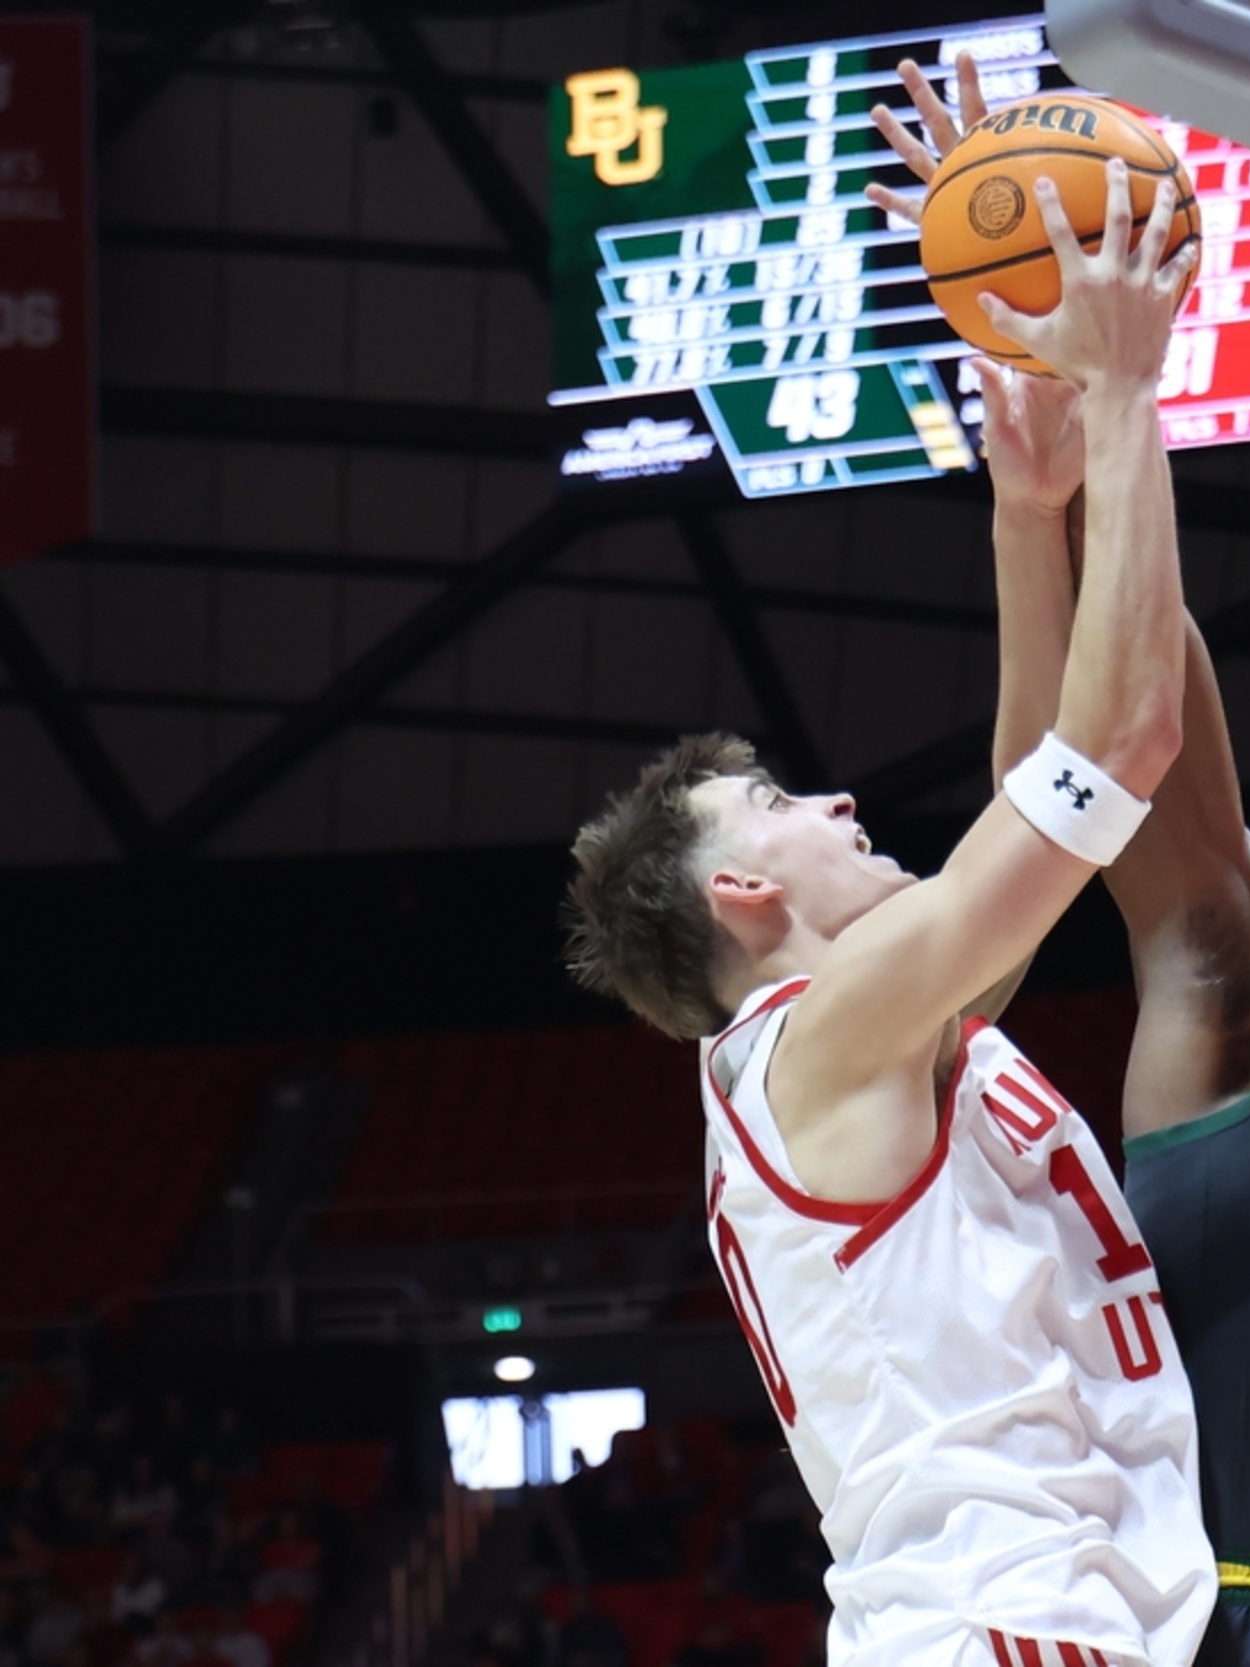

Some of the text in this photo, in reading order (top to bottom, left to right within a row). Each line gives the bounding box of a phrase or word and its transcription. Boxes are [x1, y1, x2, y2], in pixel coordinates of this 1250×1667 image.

[565, 67, 668, 185] BU
[767, 369, 861, 443] 43
[1049, 1143, 1152, 1283] 1
